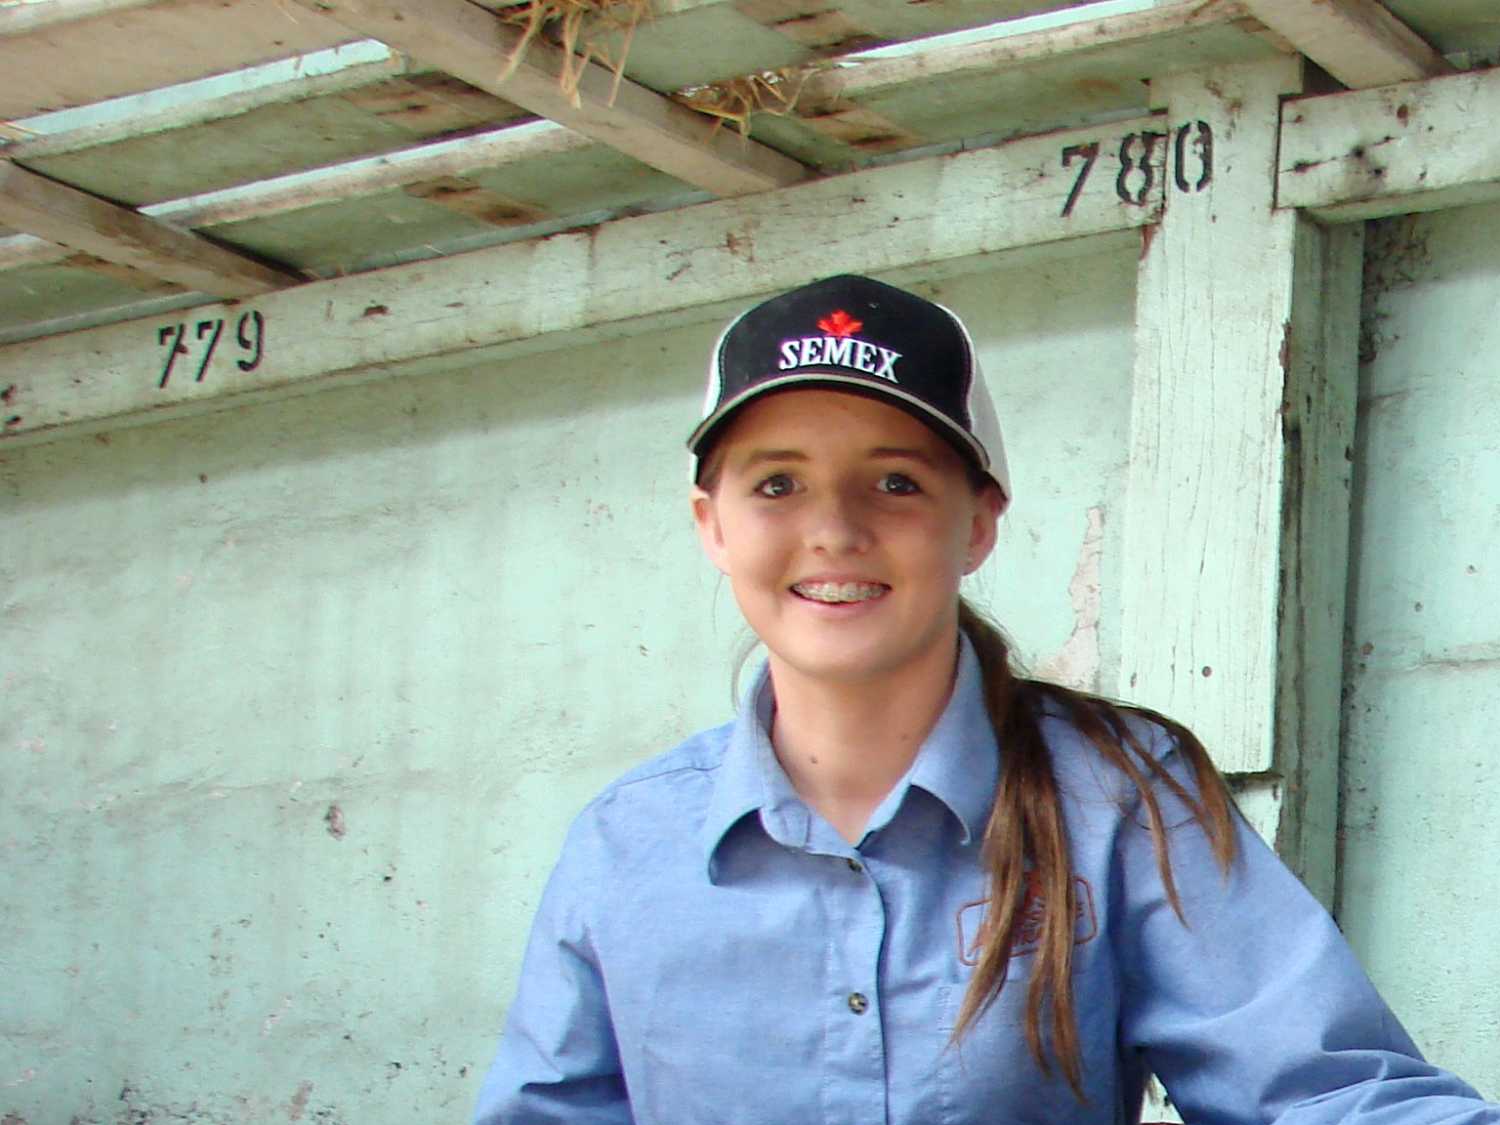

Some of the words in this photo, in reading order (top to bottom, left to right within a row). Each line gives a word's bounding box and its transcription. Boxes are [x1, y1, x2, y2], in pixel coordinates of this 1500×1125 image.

[1060, 120, 1213, 218] 780
[158, 310, 265, 389] 779
[778, 336, 902, 384] SEMEX
